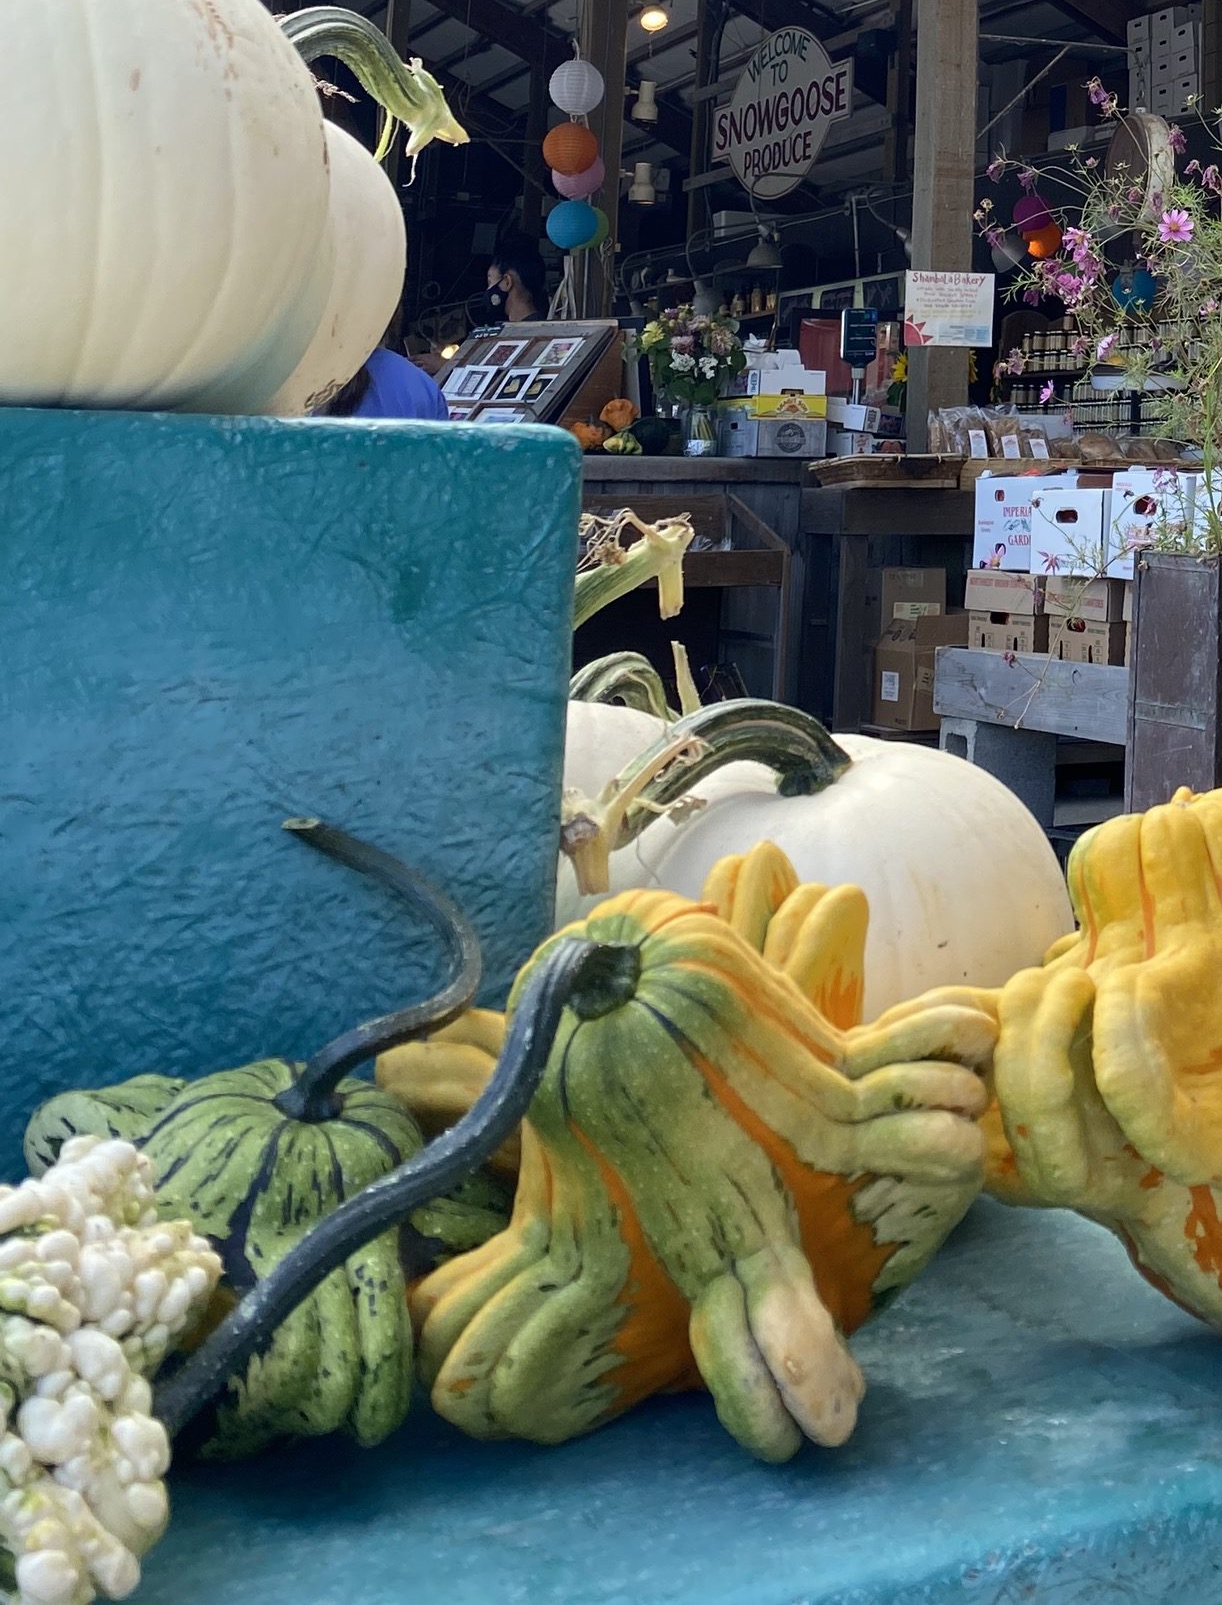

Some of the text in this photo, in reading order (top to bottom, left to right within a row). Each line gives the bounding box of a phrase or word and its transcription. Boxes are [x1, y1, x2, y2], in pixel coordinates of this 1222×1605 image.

[748, 32, 811, 83] WELCOME
[770, 59, 789, 86] TO
[716, 70, 848, 151] SNOWGOOSE
[744, 130, 812, 179] PRODUCE
[1003, 506, 1032, 518] IMPERIA
[1008, 534, 1031, 546] GARD
